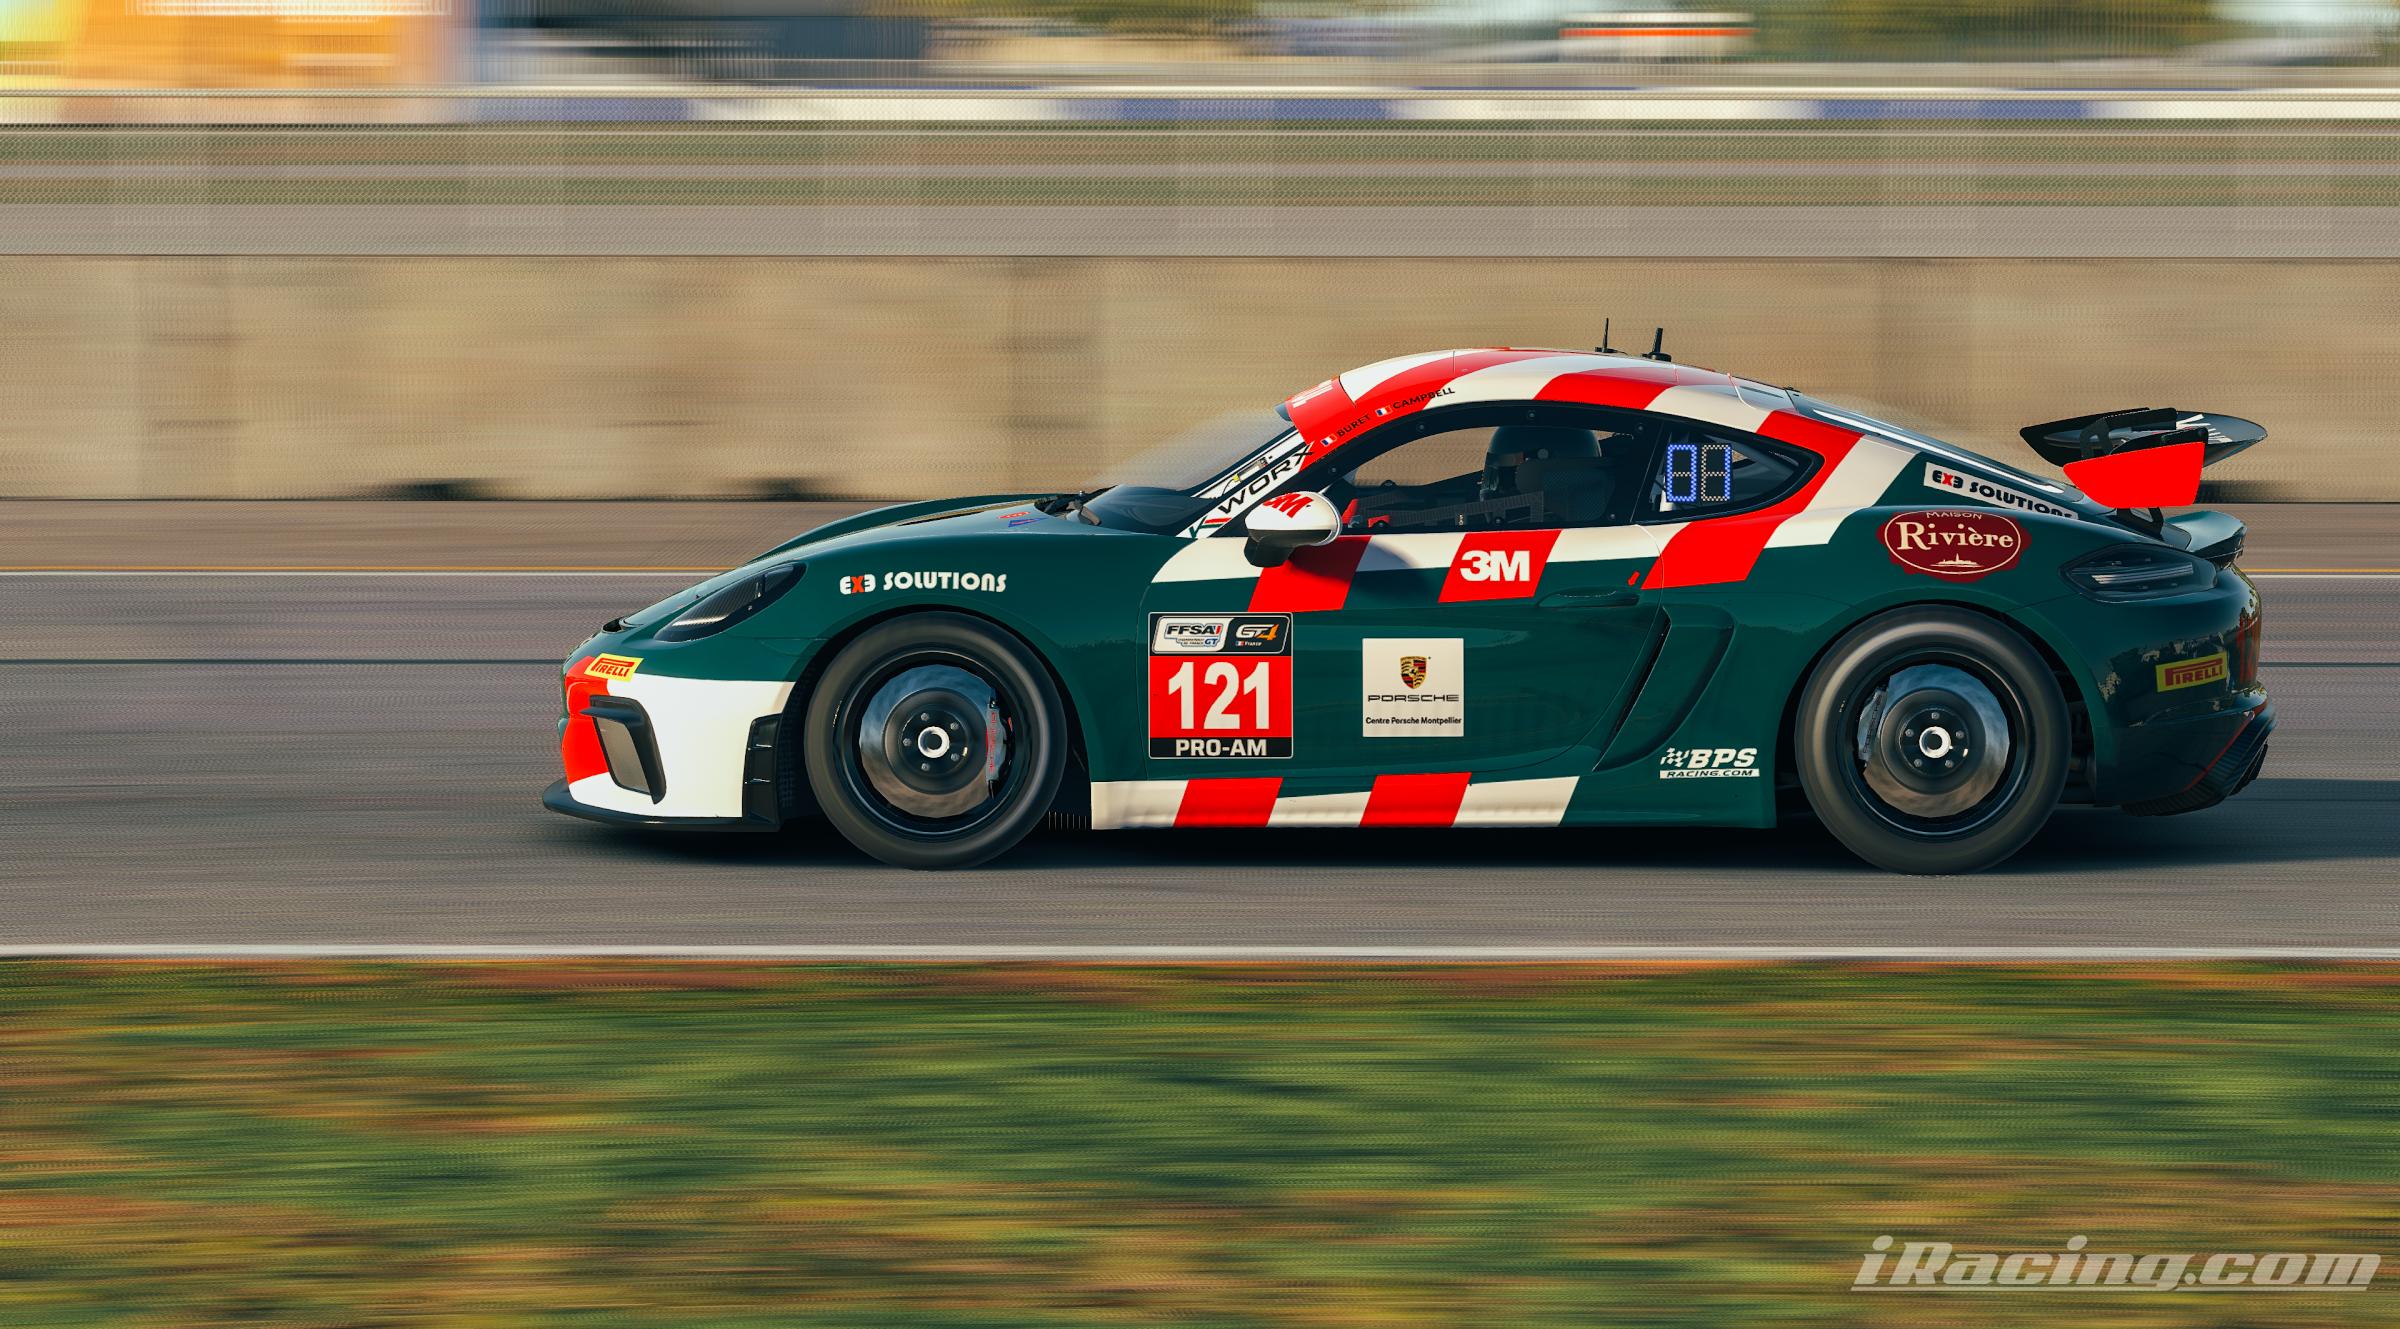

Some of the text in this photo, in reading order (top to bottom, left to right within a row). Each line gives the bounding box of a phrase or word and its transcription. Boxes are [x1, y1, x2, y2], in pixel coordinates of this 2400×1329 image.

[1392, 387, 1456, 409] CAMPBELL
[1336, 414, 1371, 437] BURET
[1926, 511, 1982, 520] MAISON
[1896, 521, 2014, 551] Rivière
[1460, 549, 1530, 582] 3M
[883, 571, 1007, 593] SOLUTIONS
[1166, 625, 1215, 635] FFSA
[1235, 623, 1279, 640] GT4
[590, 657, 635, 678] PIRELLI
[2164, 657, 2223, 687] PIRELLI
[1168, 661, 1270, 730] 121
[1368, 694, 1460, 702] PORSCHE
[1420, 717, 1462, 726] Montpellier
[1175, 739, 1268, 757] PRO-AM
[1686, 748, 1758, 769] BPS
[1666, 769, 1754, 778] RACING.COM
